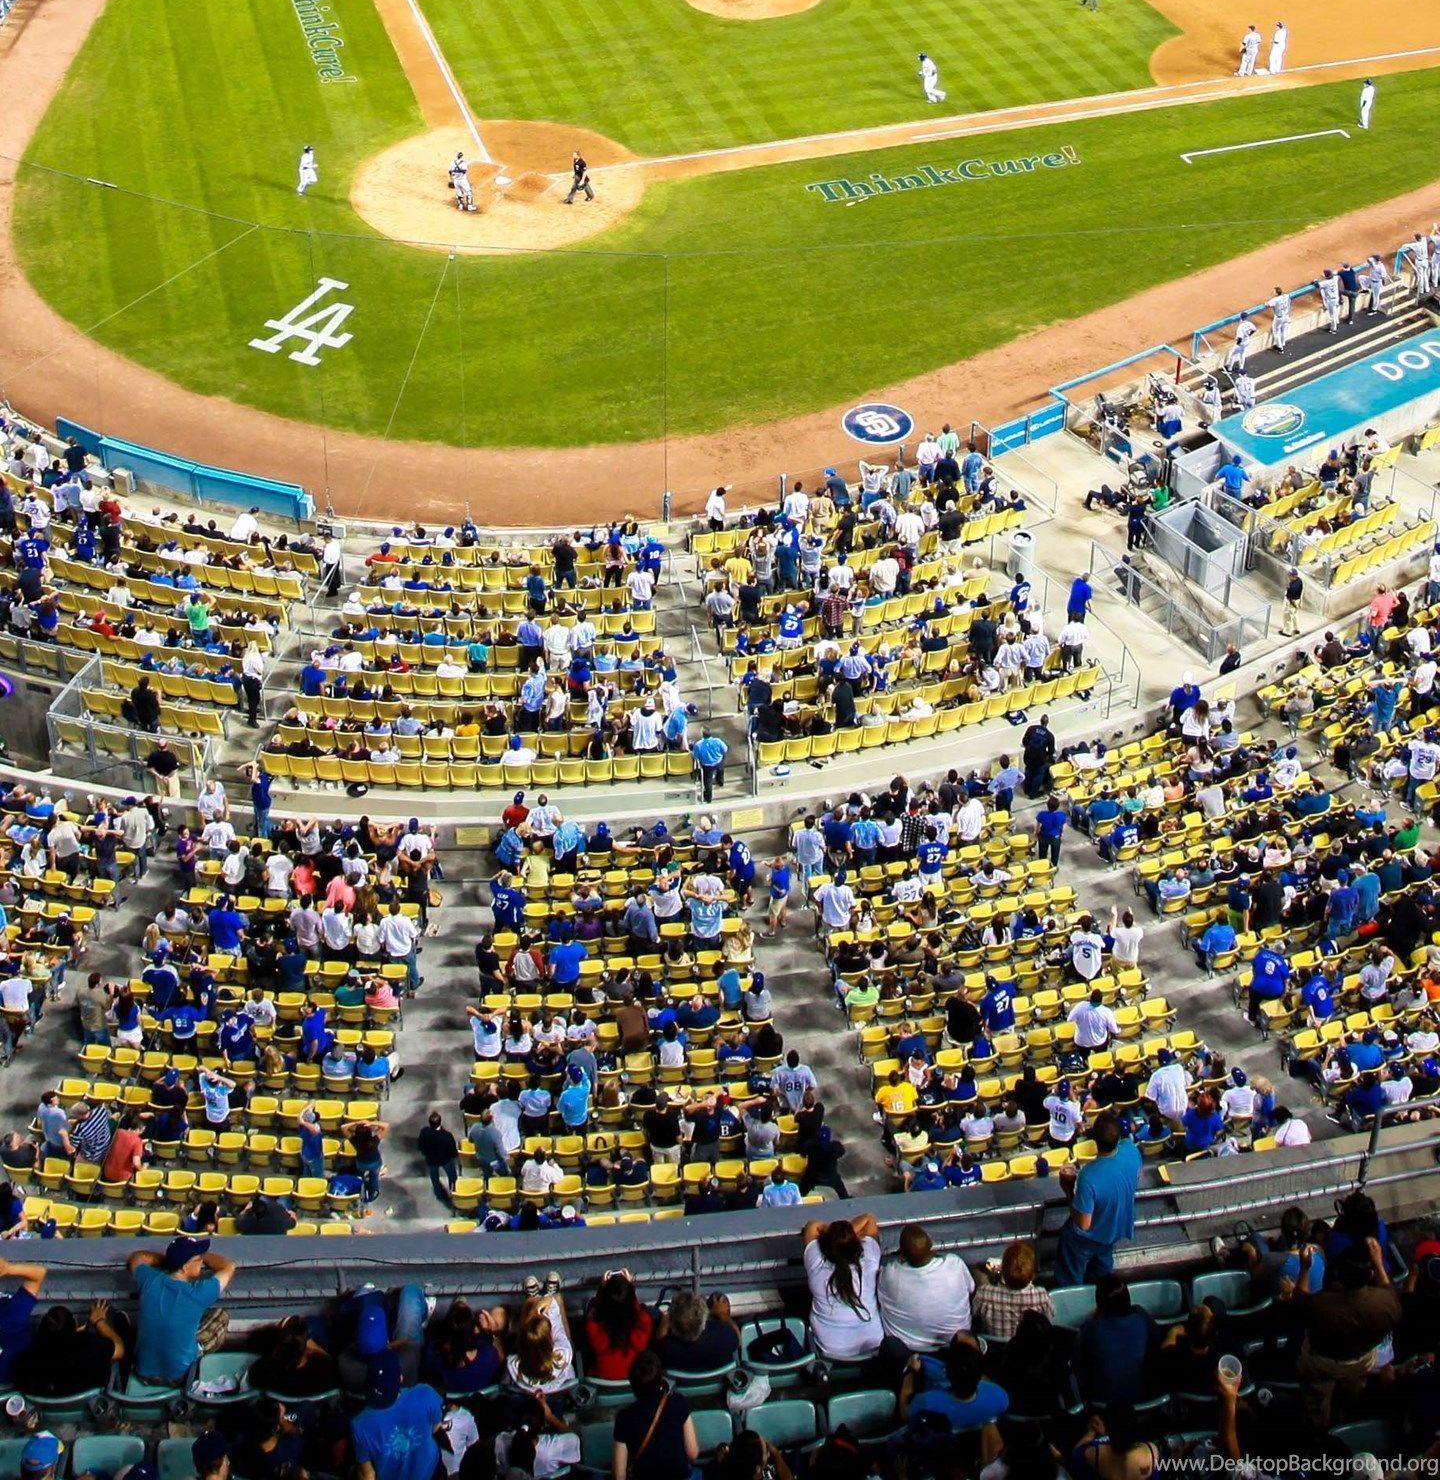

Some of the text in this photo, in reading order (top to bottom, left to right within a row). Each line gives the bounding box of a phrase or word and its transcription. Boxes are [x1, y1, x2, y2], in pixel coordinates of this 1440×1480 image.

[805, 145, 1081, 204] ThinkCure!
[247, 277, 355, 367] LA
[926, 853, 942, 864] 27
[496, 899, 509, 911] 27
[1082, 948, 1091, 959] 5
[996, 996, 1010, 1014] 27
[785, 1081, 802, 1092] 88
[1054, 1112, 1067, 1124] 10
